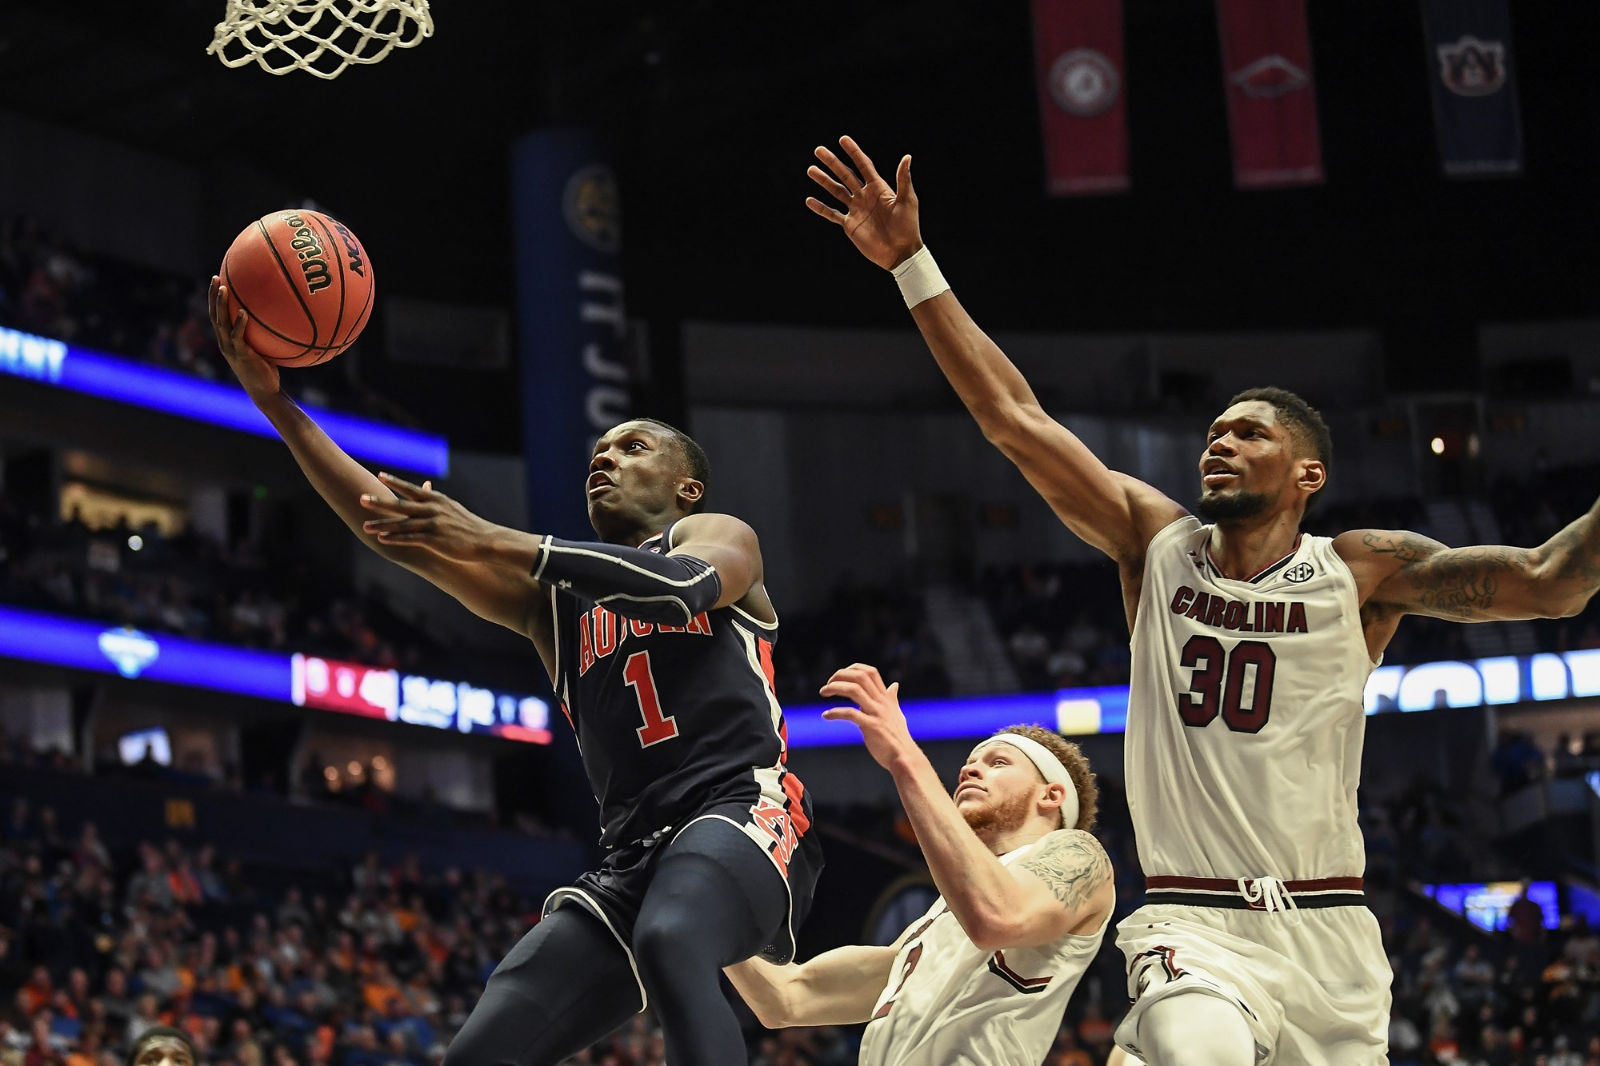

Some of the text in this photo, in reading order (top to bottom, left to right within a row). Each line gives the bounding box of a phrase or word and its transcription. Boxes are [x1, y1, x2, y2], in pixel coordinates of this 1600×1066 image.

[281, 211, 332, 295] Wilson
[1170, 585, 1309, 633] CAROLINA
[1285, 563, 1314, 583] SEC
[579, 605, 713, 677] AUN
[622, 649, 680, 749] 1
[1178, 634, 1277, 735] 30
